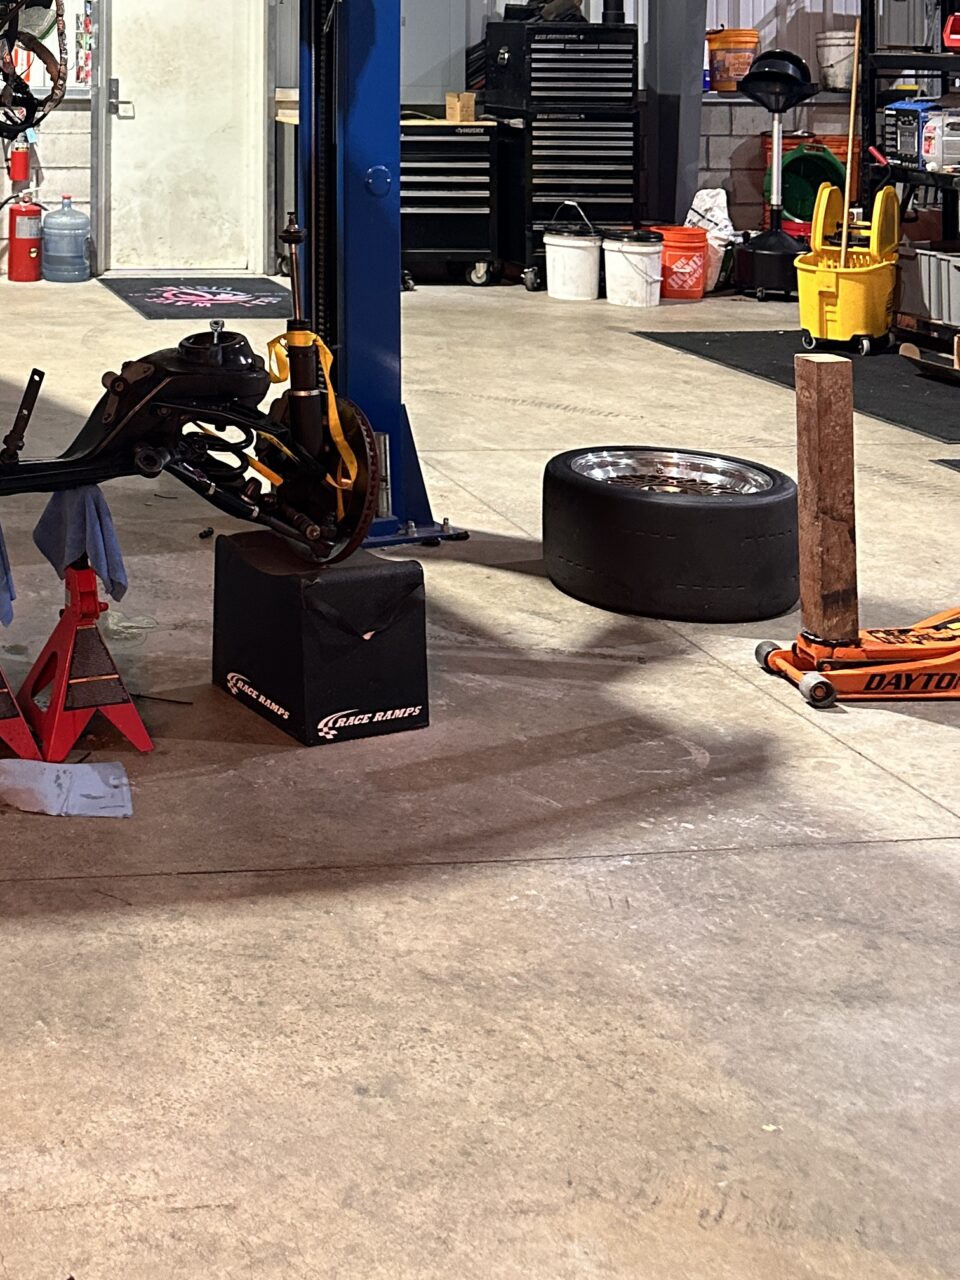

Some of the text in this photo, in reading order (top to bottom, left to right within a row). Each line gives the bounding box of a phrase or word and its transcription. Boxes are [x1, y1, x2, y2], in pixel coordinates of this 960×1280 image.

[668, 252, 704, 289] HOME
[236, 680, 290, 720] RACE RAMPS
[334, 705, 423, 729] RACE RAMPS
